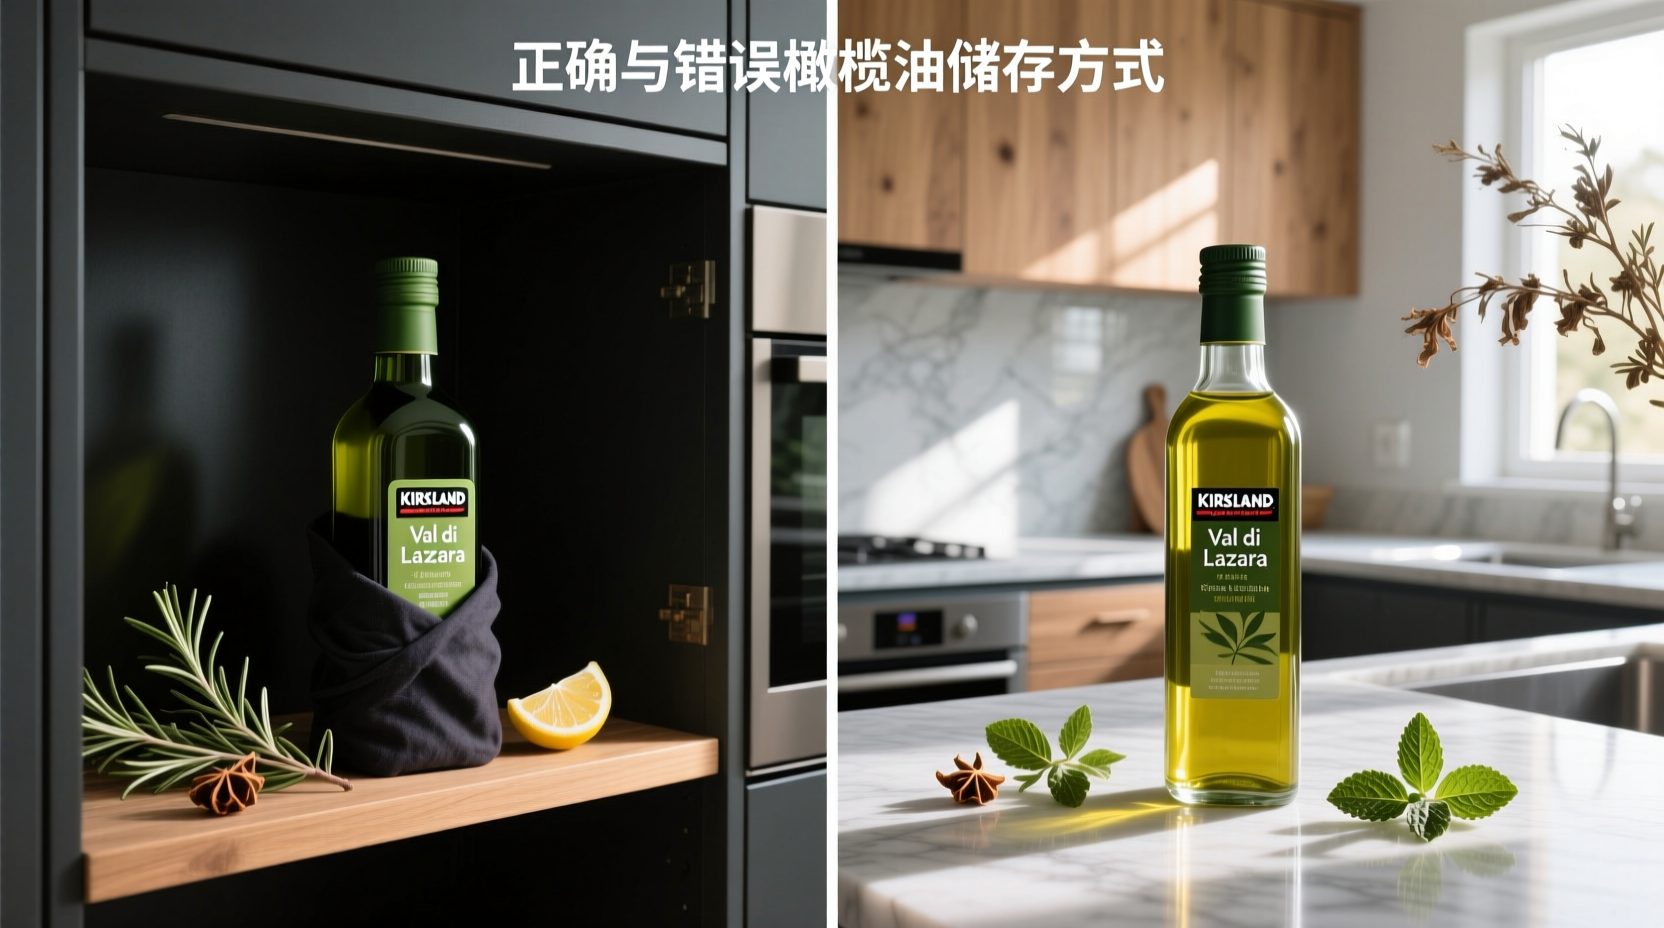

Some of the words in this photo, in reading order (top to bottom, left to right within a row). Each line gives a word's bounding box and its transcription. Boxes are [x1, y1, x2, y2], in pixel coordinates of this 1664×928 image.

[1198, 493, 1274, 508] KIRSLAND
[409, 524, 438, 544] Val
[441, 524, 458, 543] di
[1207, 527, 1238, 547] Val
[1243, 527, 1261, 547] di
[401, 546, 466, 564] Lazara
[1203, 548, 1268, 568] Lazara
